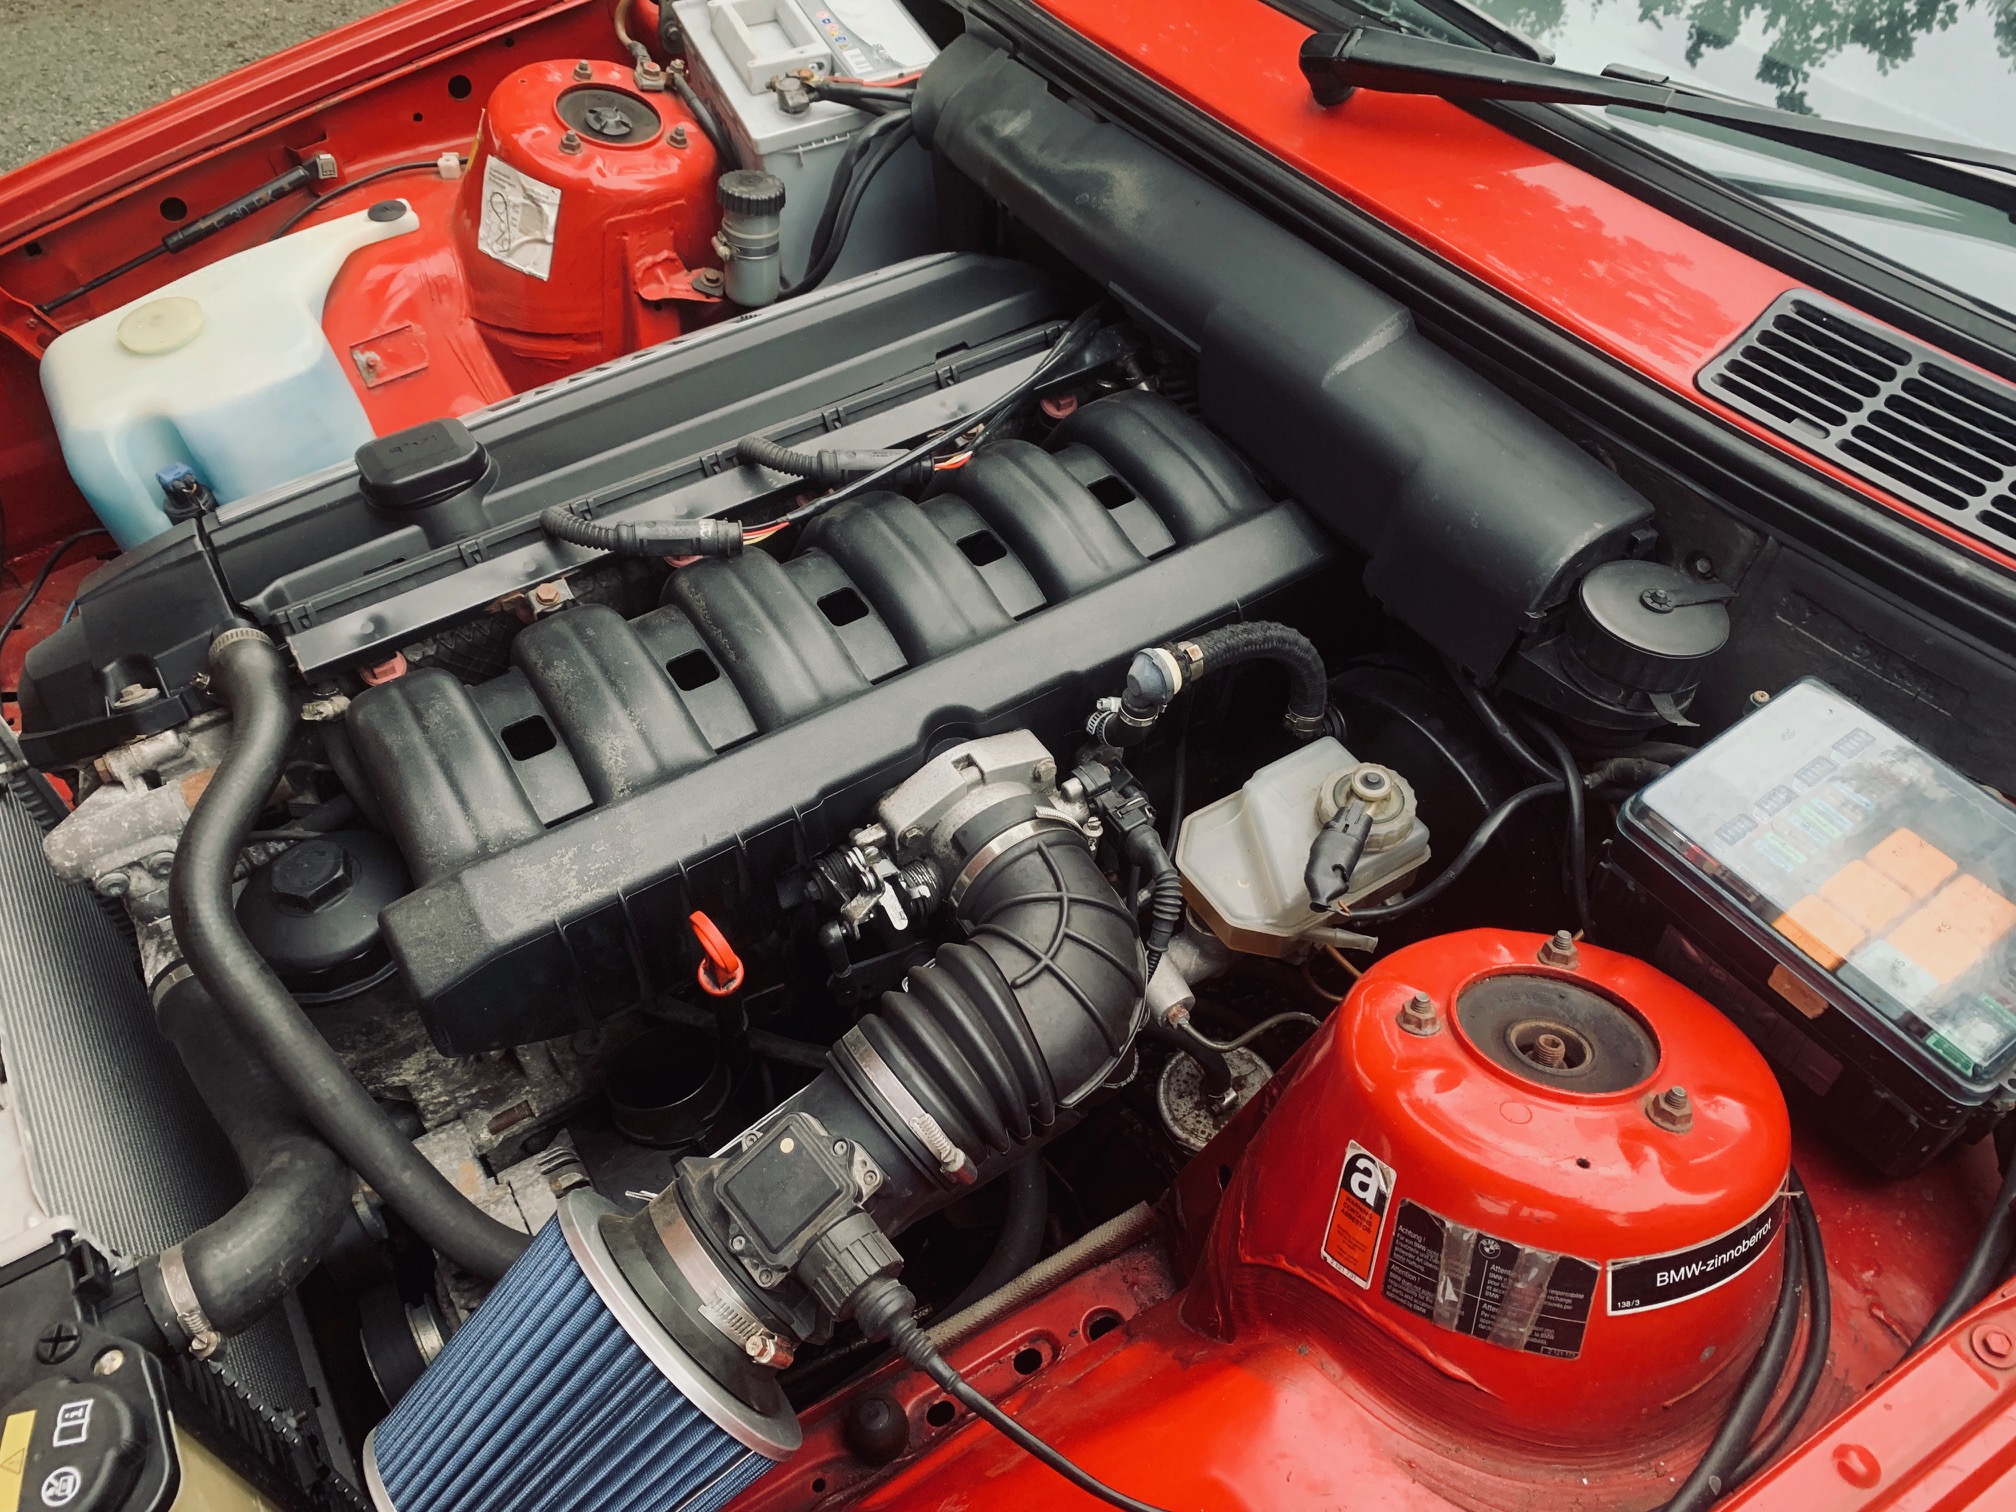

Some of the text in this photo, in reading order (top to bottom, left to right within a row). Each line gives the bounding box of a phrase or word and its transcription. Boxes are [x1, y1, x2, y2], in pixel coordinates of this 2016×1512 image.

[1350, 1157, 1380, 1208] a
[1656, 1217, 1772, 1287] BMW-zinnoberrot
[1617, 1300, 1641, 1308] 138/3
